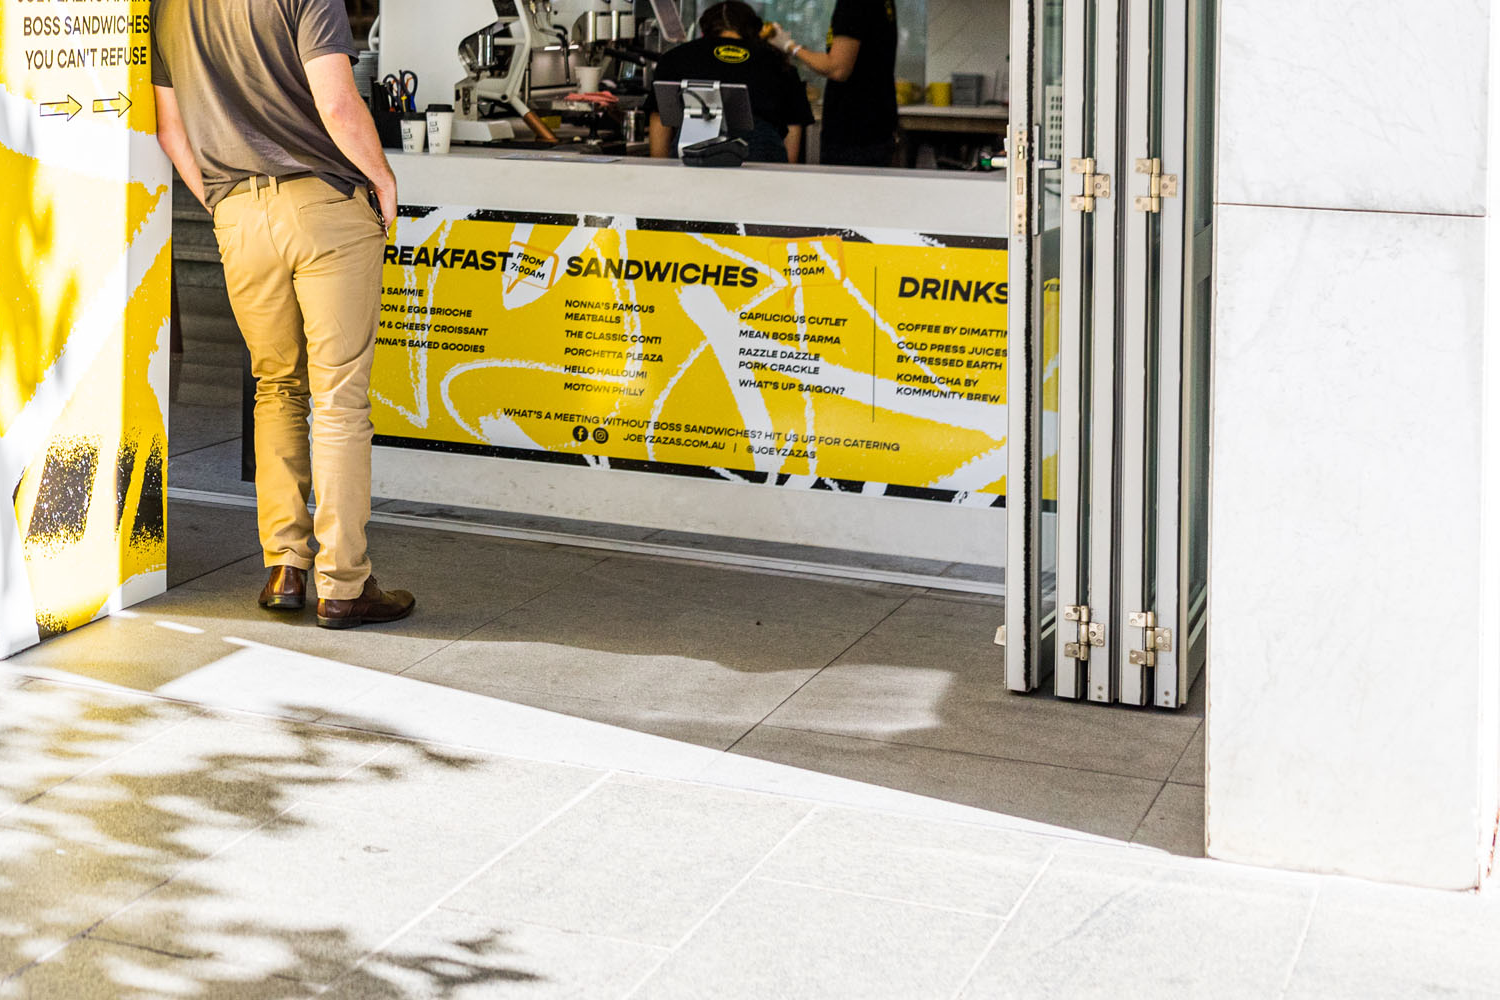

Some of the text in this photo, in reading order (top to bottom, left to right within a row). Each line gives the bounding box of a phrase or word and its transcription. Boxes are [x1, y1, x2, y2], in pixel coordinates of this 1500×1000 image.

[23, 14, 150, 36] BOSS SANDWICHES
[25, 46, 147, 71] YOU CAN'T REFUSE
[383, 244, 514, 272] REAKFAST
[517, 252, 545, 267] FROM
[787, 254, 818, 263] FROM
[511, 262, 545, 280] 7:00AM
[565, 255, 759, 288] SANDWICHES
[783, 266, 825, 276] 11:00AM
[387, 287, 424, 297] SAMMIE
[898, 276, 1008, 304] DRINKS
[400, 305, 405, 313] &
[407, 305, 428, 314] EGG
[430, 307, 473, 318] BRIOCHE
[565, 299, 655, 313] NONNA'S FAMOUS
[565, 312, 621, 324] MEATBALLS
[739, 311, 848, 327] CAPILICIOUS CUTLET
[387, 321, 393, 329] &
[395, 322, 432, 332] CHEESY
[433, 324, 489, 336] CROISSANT
[897, 322, 942, 334] COFFEE
[943, 326, 958, 334] BY
[565, 330, 662, 344] THE CLASSIC CONTI
[739, 330, 841, 345] MEAN BOSS PARMA
[408, 339, 439, 349] BAKED
[441, 342, 485, 353] GOODIES
[897, 341, 1007, 357] COLD PRESS JUICES
[564, 347, 664, 362] PORCHETTA PLEAZA
[739, 348, 820, 361] RAZZLE DAZZLE
[738, 361, 820, 375] PORK CRACKLE
[896, 355, 1002, 370] BY PRESSED EARTH
[564, 365, 647, 379] HELLO HALLOUMI
[738, 379, 845, 395] WHAT'S UP SAIGON?
[896, 373, 979, 387] KOMBUCHA BY
[564, 382, 644, 396] MOTOWN PHILLY
[896, 387, 1001, 403] KOMMUNITY BREW
[503, 408, 900, 451] WHAT'S A MEETING WITHOUT BOSS SANDWICHES? HIT US UP FOR CATERING
[623, 433, 816, 459] JOEYZAZAS.COM.AU @JOEYZAZAS
